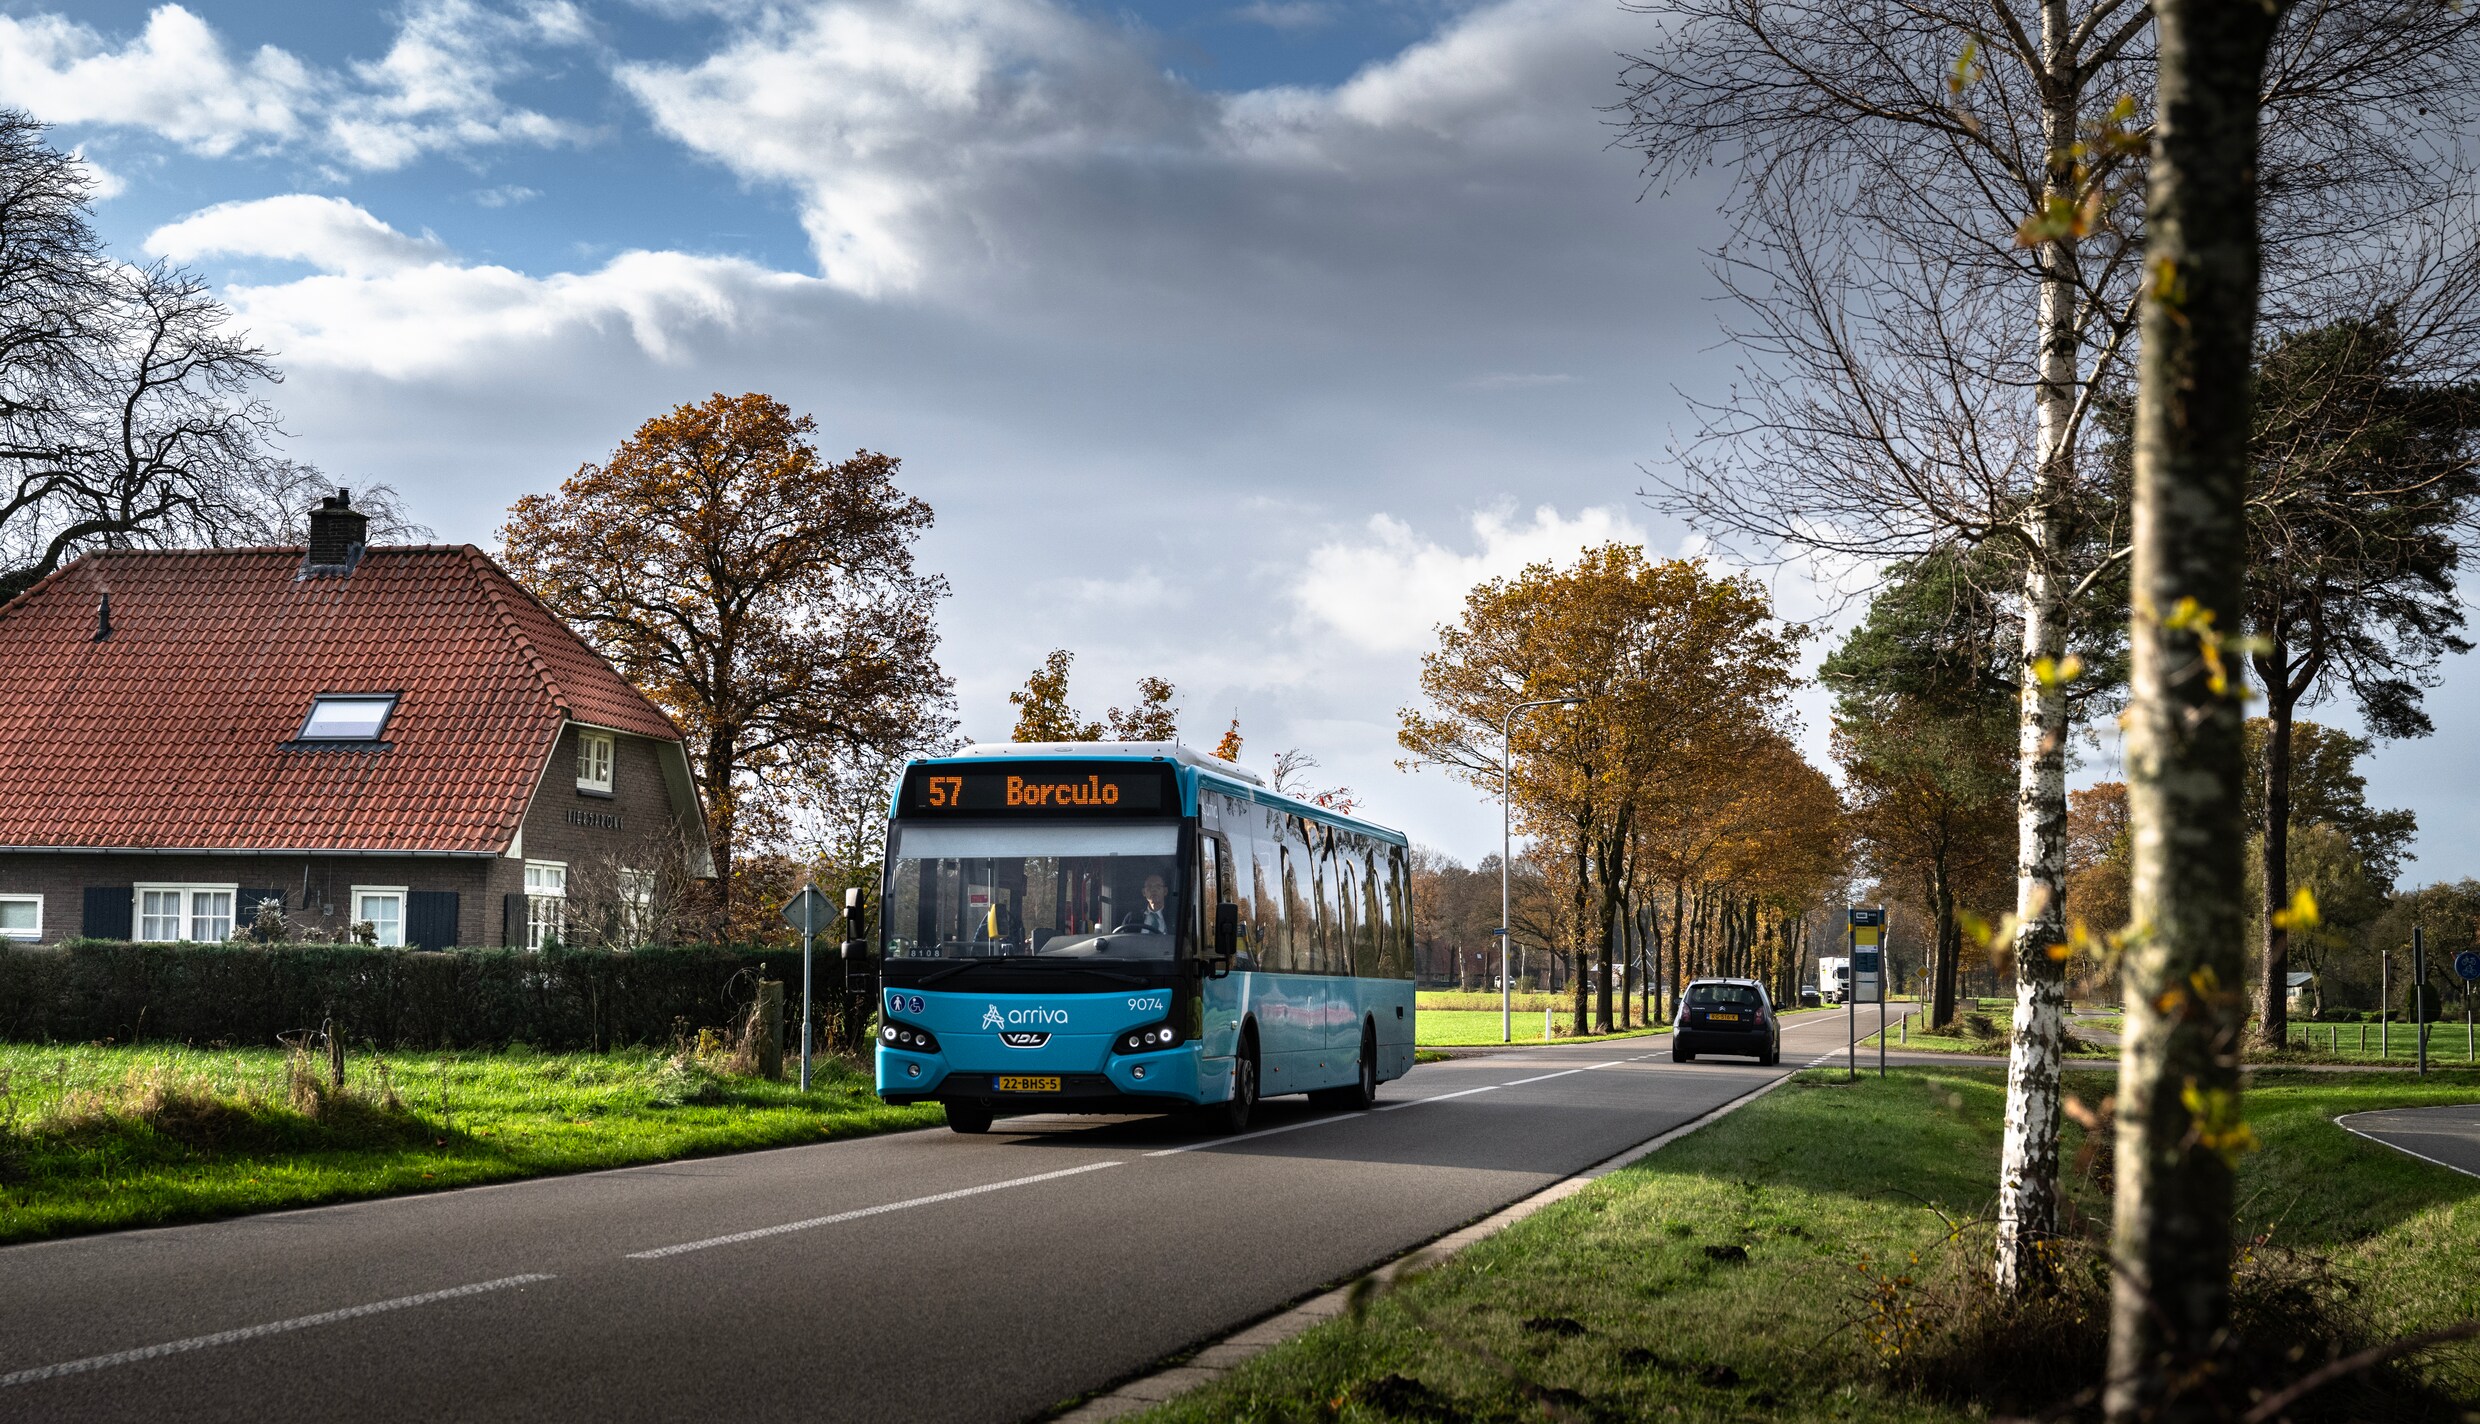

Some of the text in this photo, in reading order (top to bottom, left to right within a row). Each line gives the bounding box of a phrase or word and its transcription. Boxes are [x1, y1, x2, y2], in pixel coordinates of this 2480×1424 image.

[929, 775, 1119, 806] 57 Borculo
[910, 949, 940, 957] 8108
[1127, 998, 1163, 1011] 9074
[1008, 1005, 1068, 1024] arriva
[1007, 1033, 1042, 1043] VDL
[1003, 1078, 1057, 1089] 22-BHS-5
